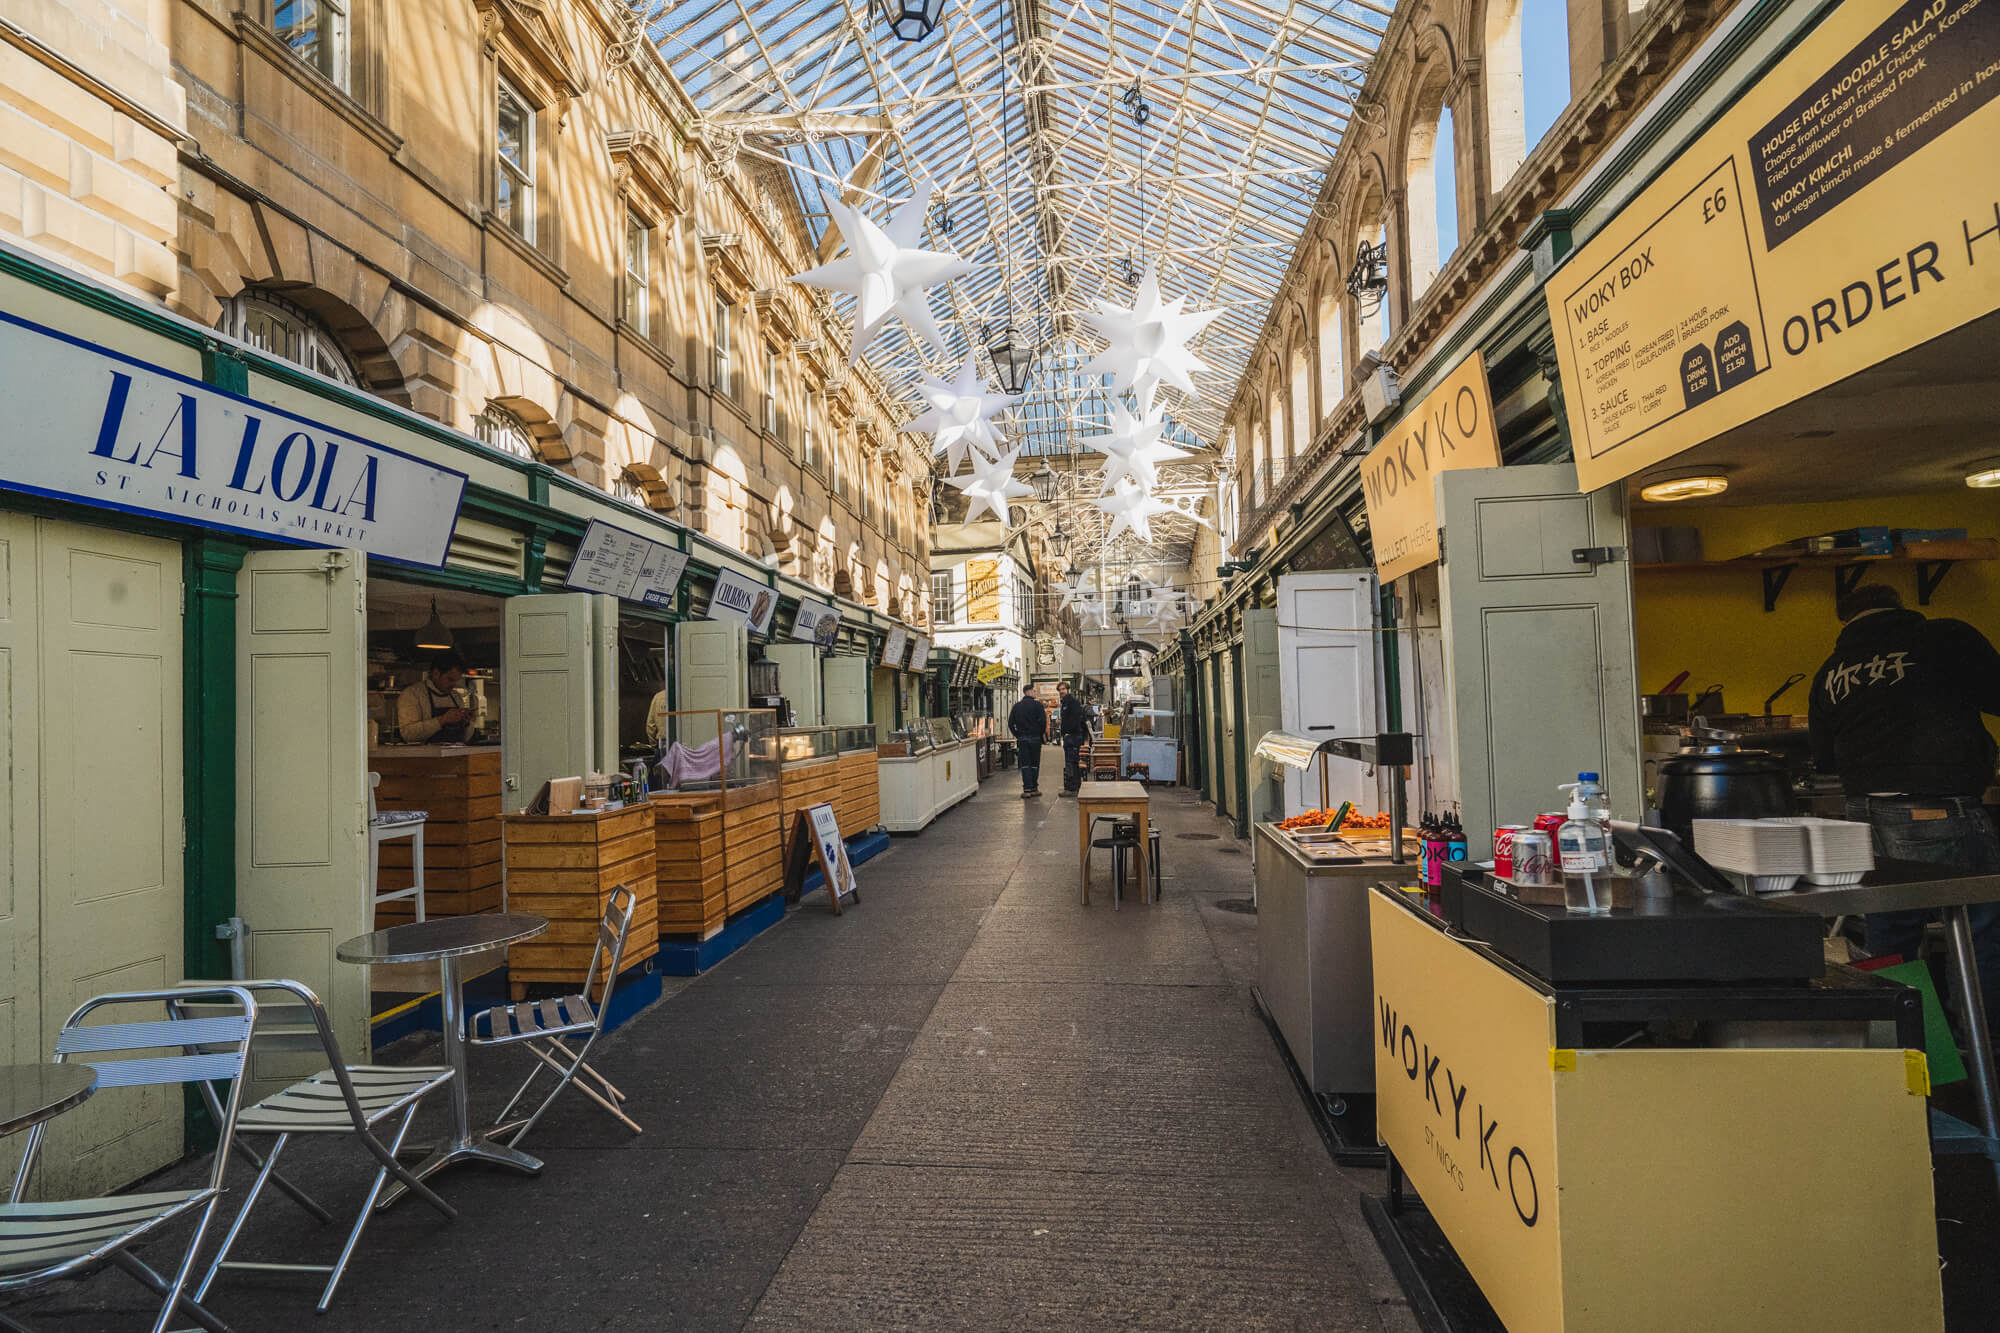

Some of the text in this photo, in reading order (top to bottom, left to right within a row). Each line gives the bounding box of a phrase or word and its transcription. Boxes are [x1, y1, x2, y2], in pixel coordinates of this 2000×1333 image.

[1761, 0, 1946, 159] HOUSE RICE NOODLE SALAD
[1764, 143, 1797, 173] Choose
[1797, 127, 1819, 148] from
[1820, 97, 1855, 127] Korean
[1857, 72, 1884, 99] Fried
[1938, 0, 1982, 32] Korea
[1767, 57, 1927, 188] Fried Cauliflower or Braised Pork
[1775, 210, 1791, 227] Our
[1792, 191, 1820, 215] vegan
[1820, 167, 1852, 196] kimchi
[1853, 145, 1882, 171] made
[1884, 136, 1895, 149] &
[1895, 88, 1958, 142] fermented
[1960, 80, 1973, 95] in
[1771, 144, 1853, 212] WOKY KIMCHI
[1702, 186, 1727, 225] £6
[1574, 246, 1655, 324] WOKY BOX
[1782, 241, 1945, 356] ORDER
[1682, 304, 1729, 340] BRAISED PORK
[1688, 306, 1708, 325] HOUR
[1579, 318, 1609, 349] 1. BASE
[1589, 320, 1630, 353] RICE NOODLES
[1635, 328, 1674, 358] KOREAN FRIED
[1724, 334, 1740, 350] ADD
[1586, 340, 1631, 380] 2. TOPPING
[1636, 339, 1676, 369] CAULIFLOWER
[1688, 355, 1703, 370] ADD
[1720, 343, 1747, 364] KIMCHI
[1726, 357, 1746, 374] £1.50
[1686, 365, 1708, 383] DRINK
[1690, 377, 1708, 392] £1.50
[1592, 389, 1629, 420] 3. SAUCE
[1641, 384, 1667, 403] THAI RED
[1643, 398, 1662, 413] CURRY
[89, 370, 379, 523] LA LOLA
[1367, 385, 1478, 511] WOKYKO
[96, 470, 367, 541] ST. NICHOLAS MARKET
[1380, 536, 1408, 567] COLLECT
[1409, 521, 1433, 552] HERE
[717, 583, 753, 609] CHURROS
[1825, 651, 1917, 705] 你好
[1379, 995, 1539, 1228] WOKYKO
[1425, 1125, 1434, 1152] ST
